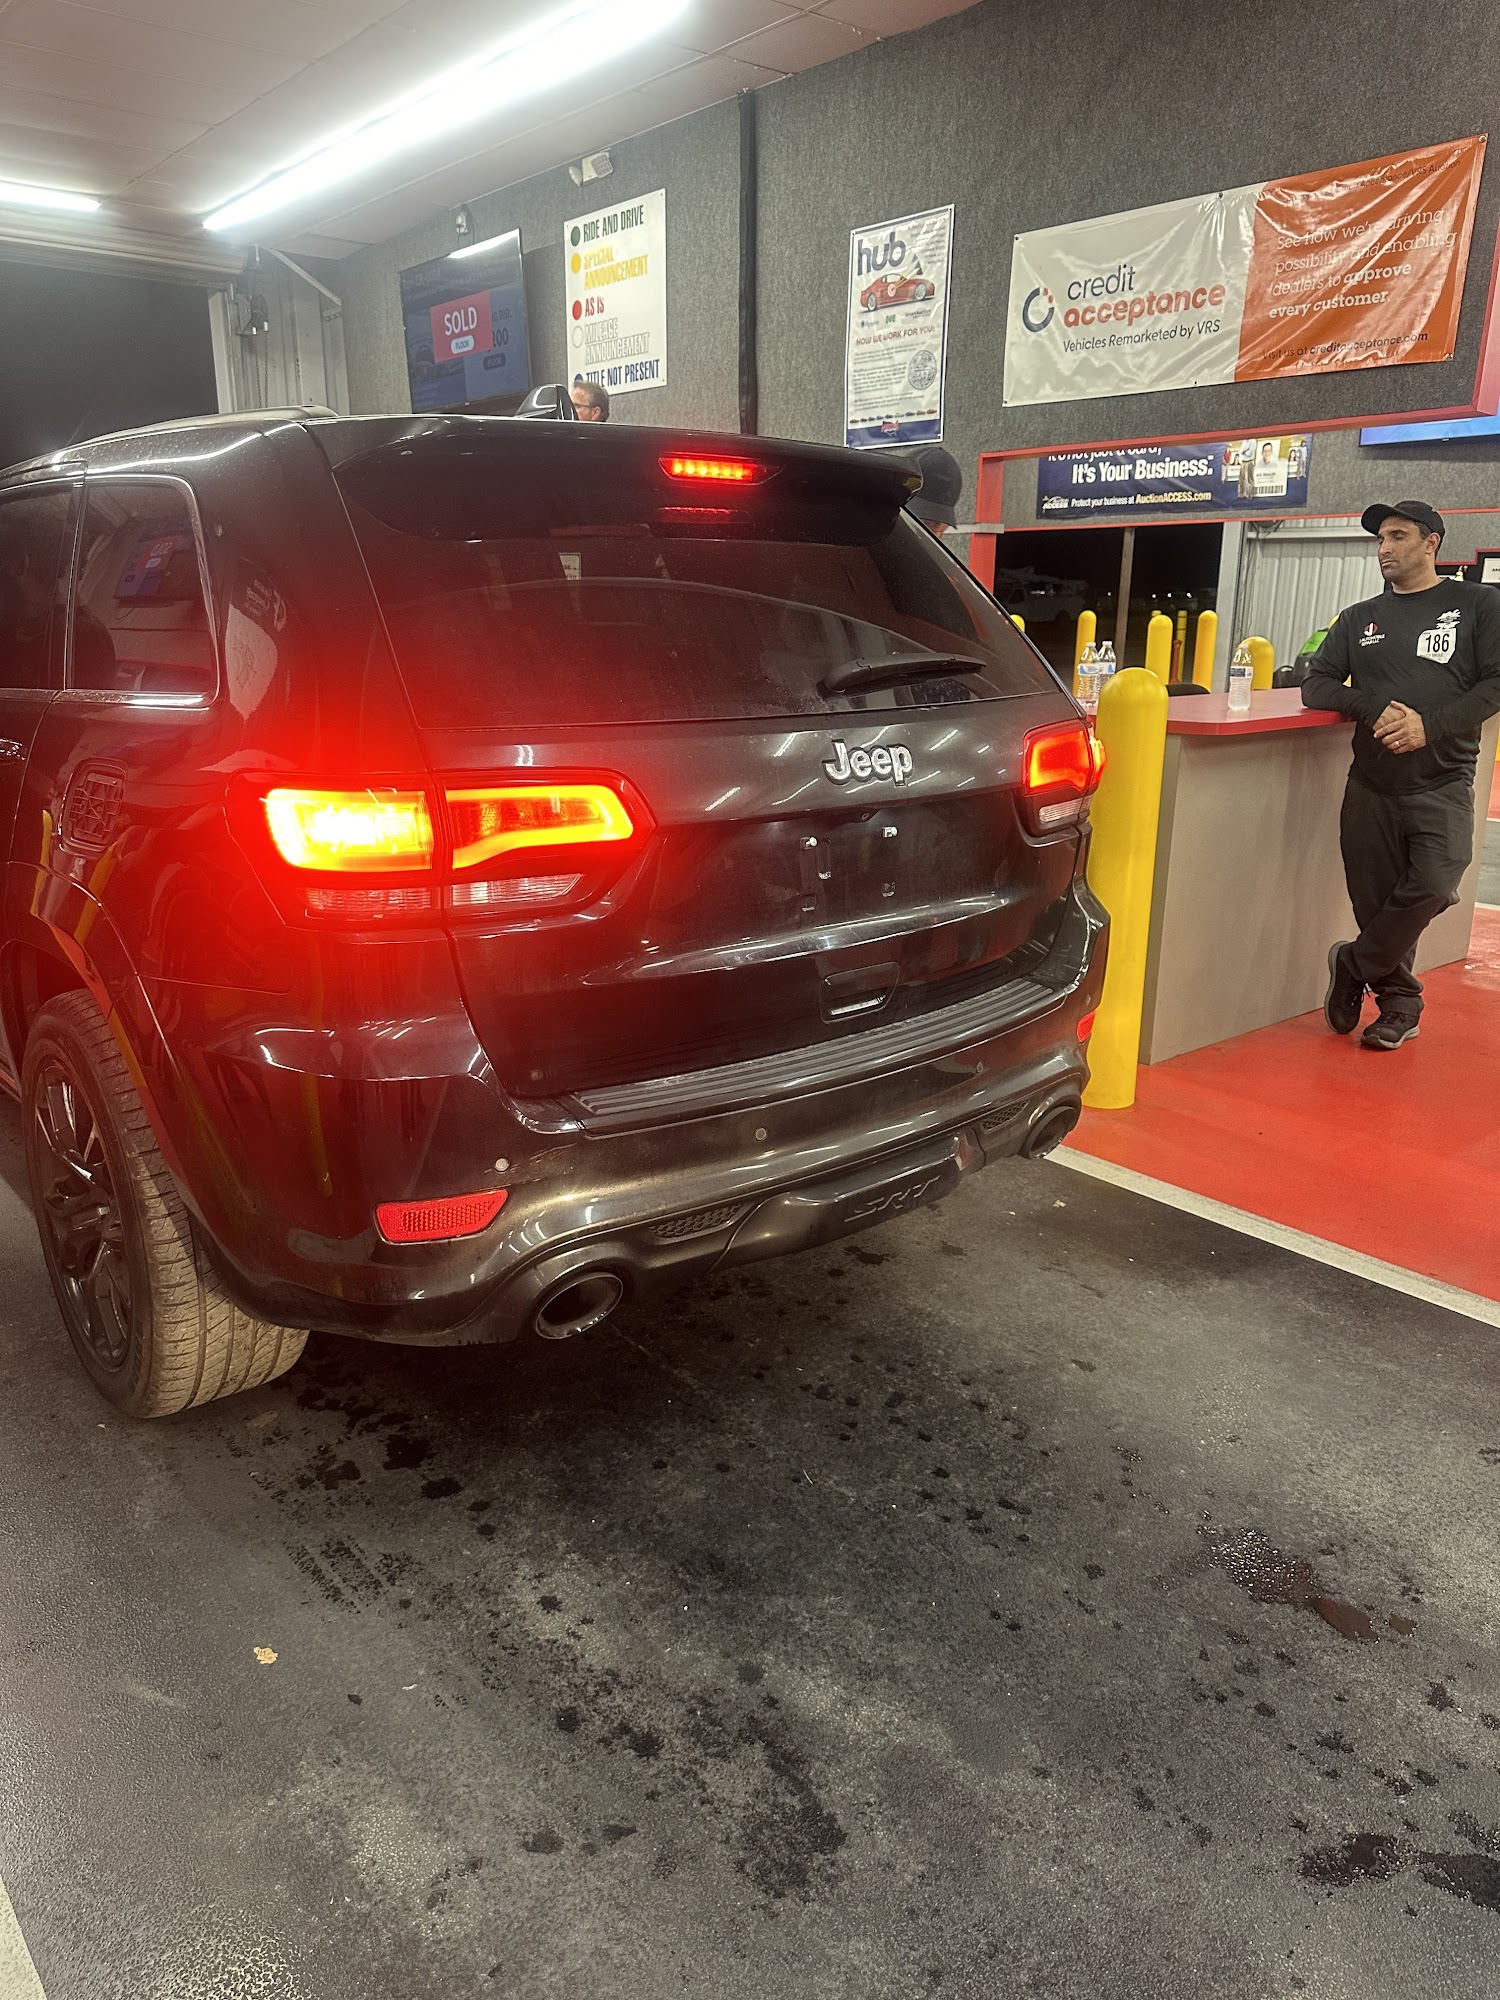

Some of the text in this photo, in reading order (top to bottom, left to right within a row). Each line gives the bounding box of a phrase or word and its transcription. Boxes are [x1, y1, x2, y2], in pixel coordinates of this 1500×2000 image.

[583, 204, 644, 243] RIDE AND DRIVE
[857, 231, 907, 276] hub
[1277, 236, 1301, 250] See
[1350, 242, 1380, 260] and
[1382, 230, 1457, 254] enabling
[583, 247, 615, 270] SPECIAL
[585, 254, 649, 291] ANNOUNCEMENT
[1067, 264, 1136, 301] credit
[1272, 262, 1412, 296] dealers to approve
[444, 306, 478, 336] SOLD
[585, 296, 605, 318] AS IS
[1063, 284, 1226, 328] acceptance
[1269, 301, 1310, 319] every
[584, 317, 618, 345] MILEAGE
[856, 336, 872, 346] HOW
[872, 334, 882, 344] WE
[882, 330, 902, 341] WORK
[903, 328, 918, 337] FOR
[1063, 319, 1221, 353] Vehicles Remarketed by VRS
[585, 331, 650, 366] ANNOUNCEMENT
[1296, 345, 1308, 356] at
[586, 358, 660, 388] TITLE NOT PRESENT
[1071, 463, 1097, 485] It's
[1098, 461, 1133, 483] Your
[1071, 497, 1092, 508] Protect
[1091, 498, 1104, 509] your
[1103, 496, 1128, 506] business
[1128, 495, 1135, 504] at
[1135, 491, 1212, 505] AuctionACCESS.com
[1425, 633, 1450, 653] 186
[822, 739, 914, 787] Jeep
